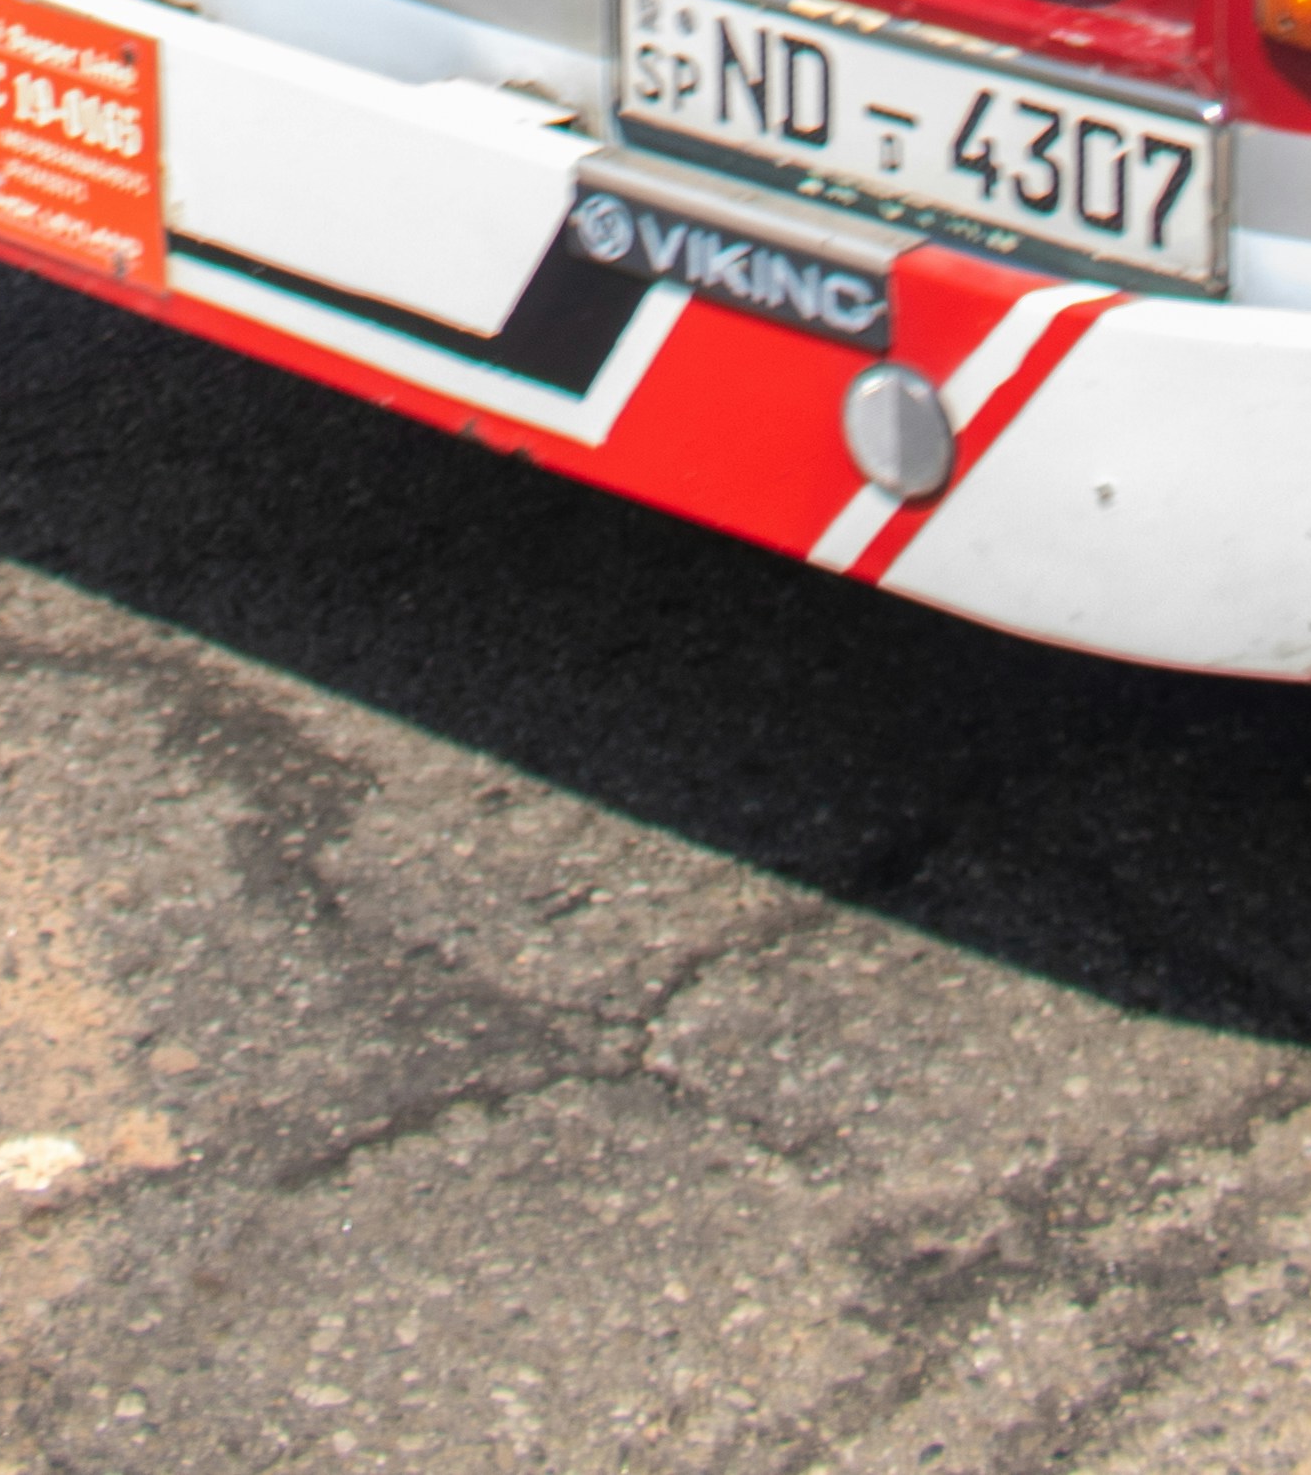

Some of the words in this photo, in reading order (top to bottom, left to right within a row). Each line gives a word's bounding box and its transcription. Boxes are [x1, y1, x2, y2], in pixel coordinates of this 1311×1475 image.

[715, 16, 831, 148] ND
[953, 90, 1193, 249] 4307
[635, 213, 889, 333] VIKING
